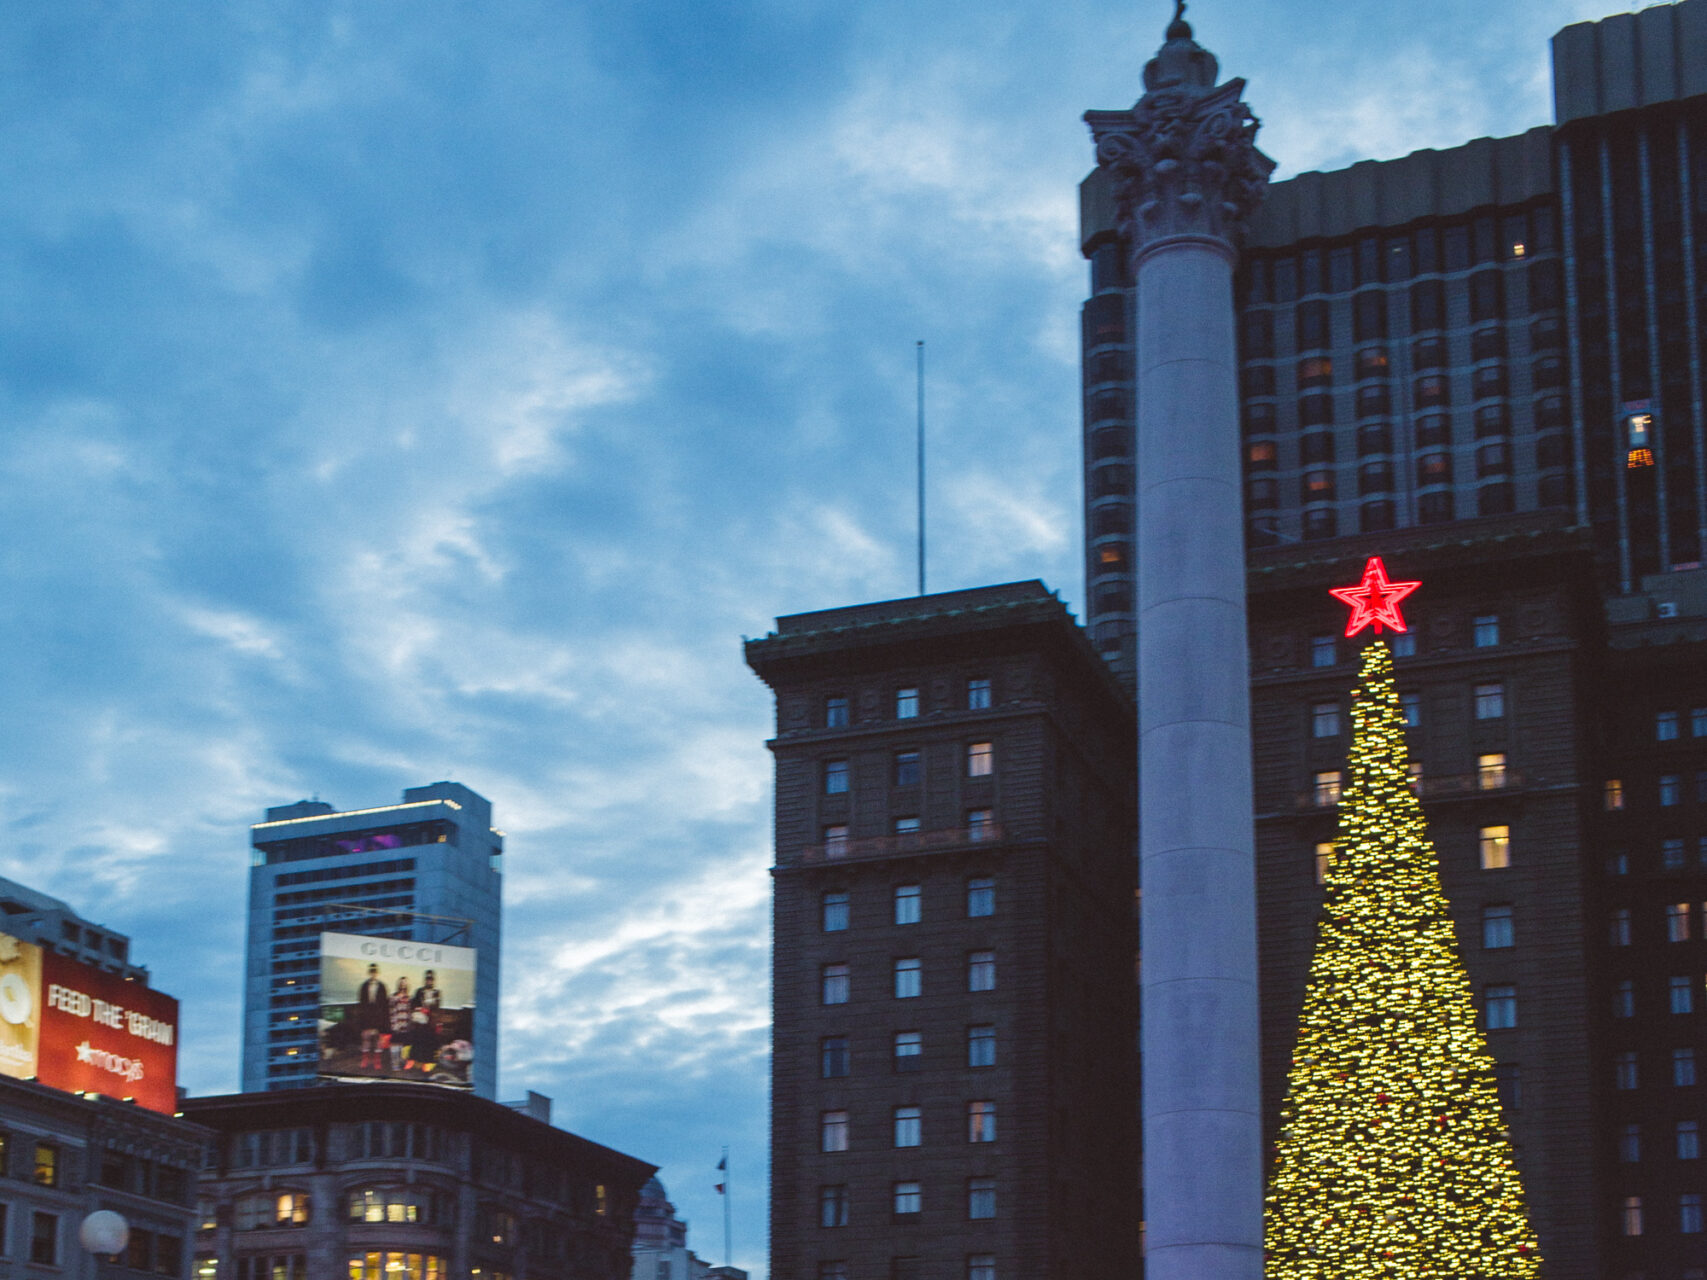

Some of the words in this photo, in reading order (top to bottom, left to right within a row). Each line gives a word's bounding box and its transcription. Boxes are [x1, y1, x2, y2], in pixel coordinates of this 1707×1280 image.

[360, 942, 442, 963] GUCCI
[48, 984, 91, 1017] FEED
[92, 998, 124, 1029] THE
